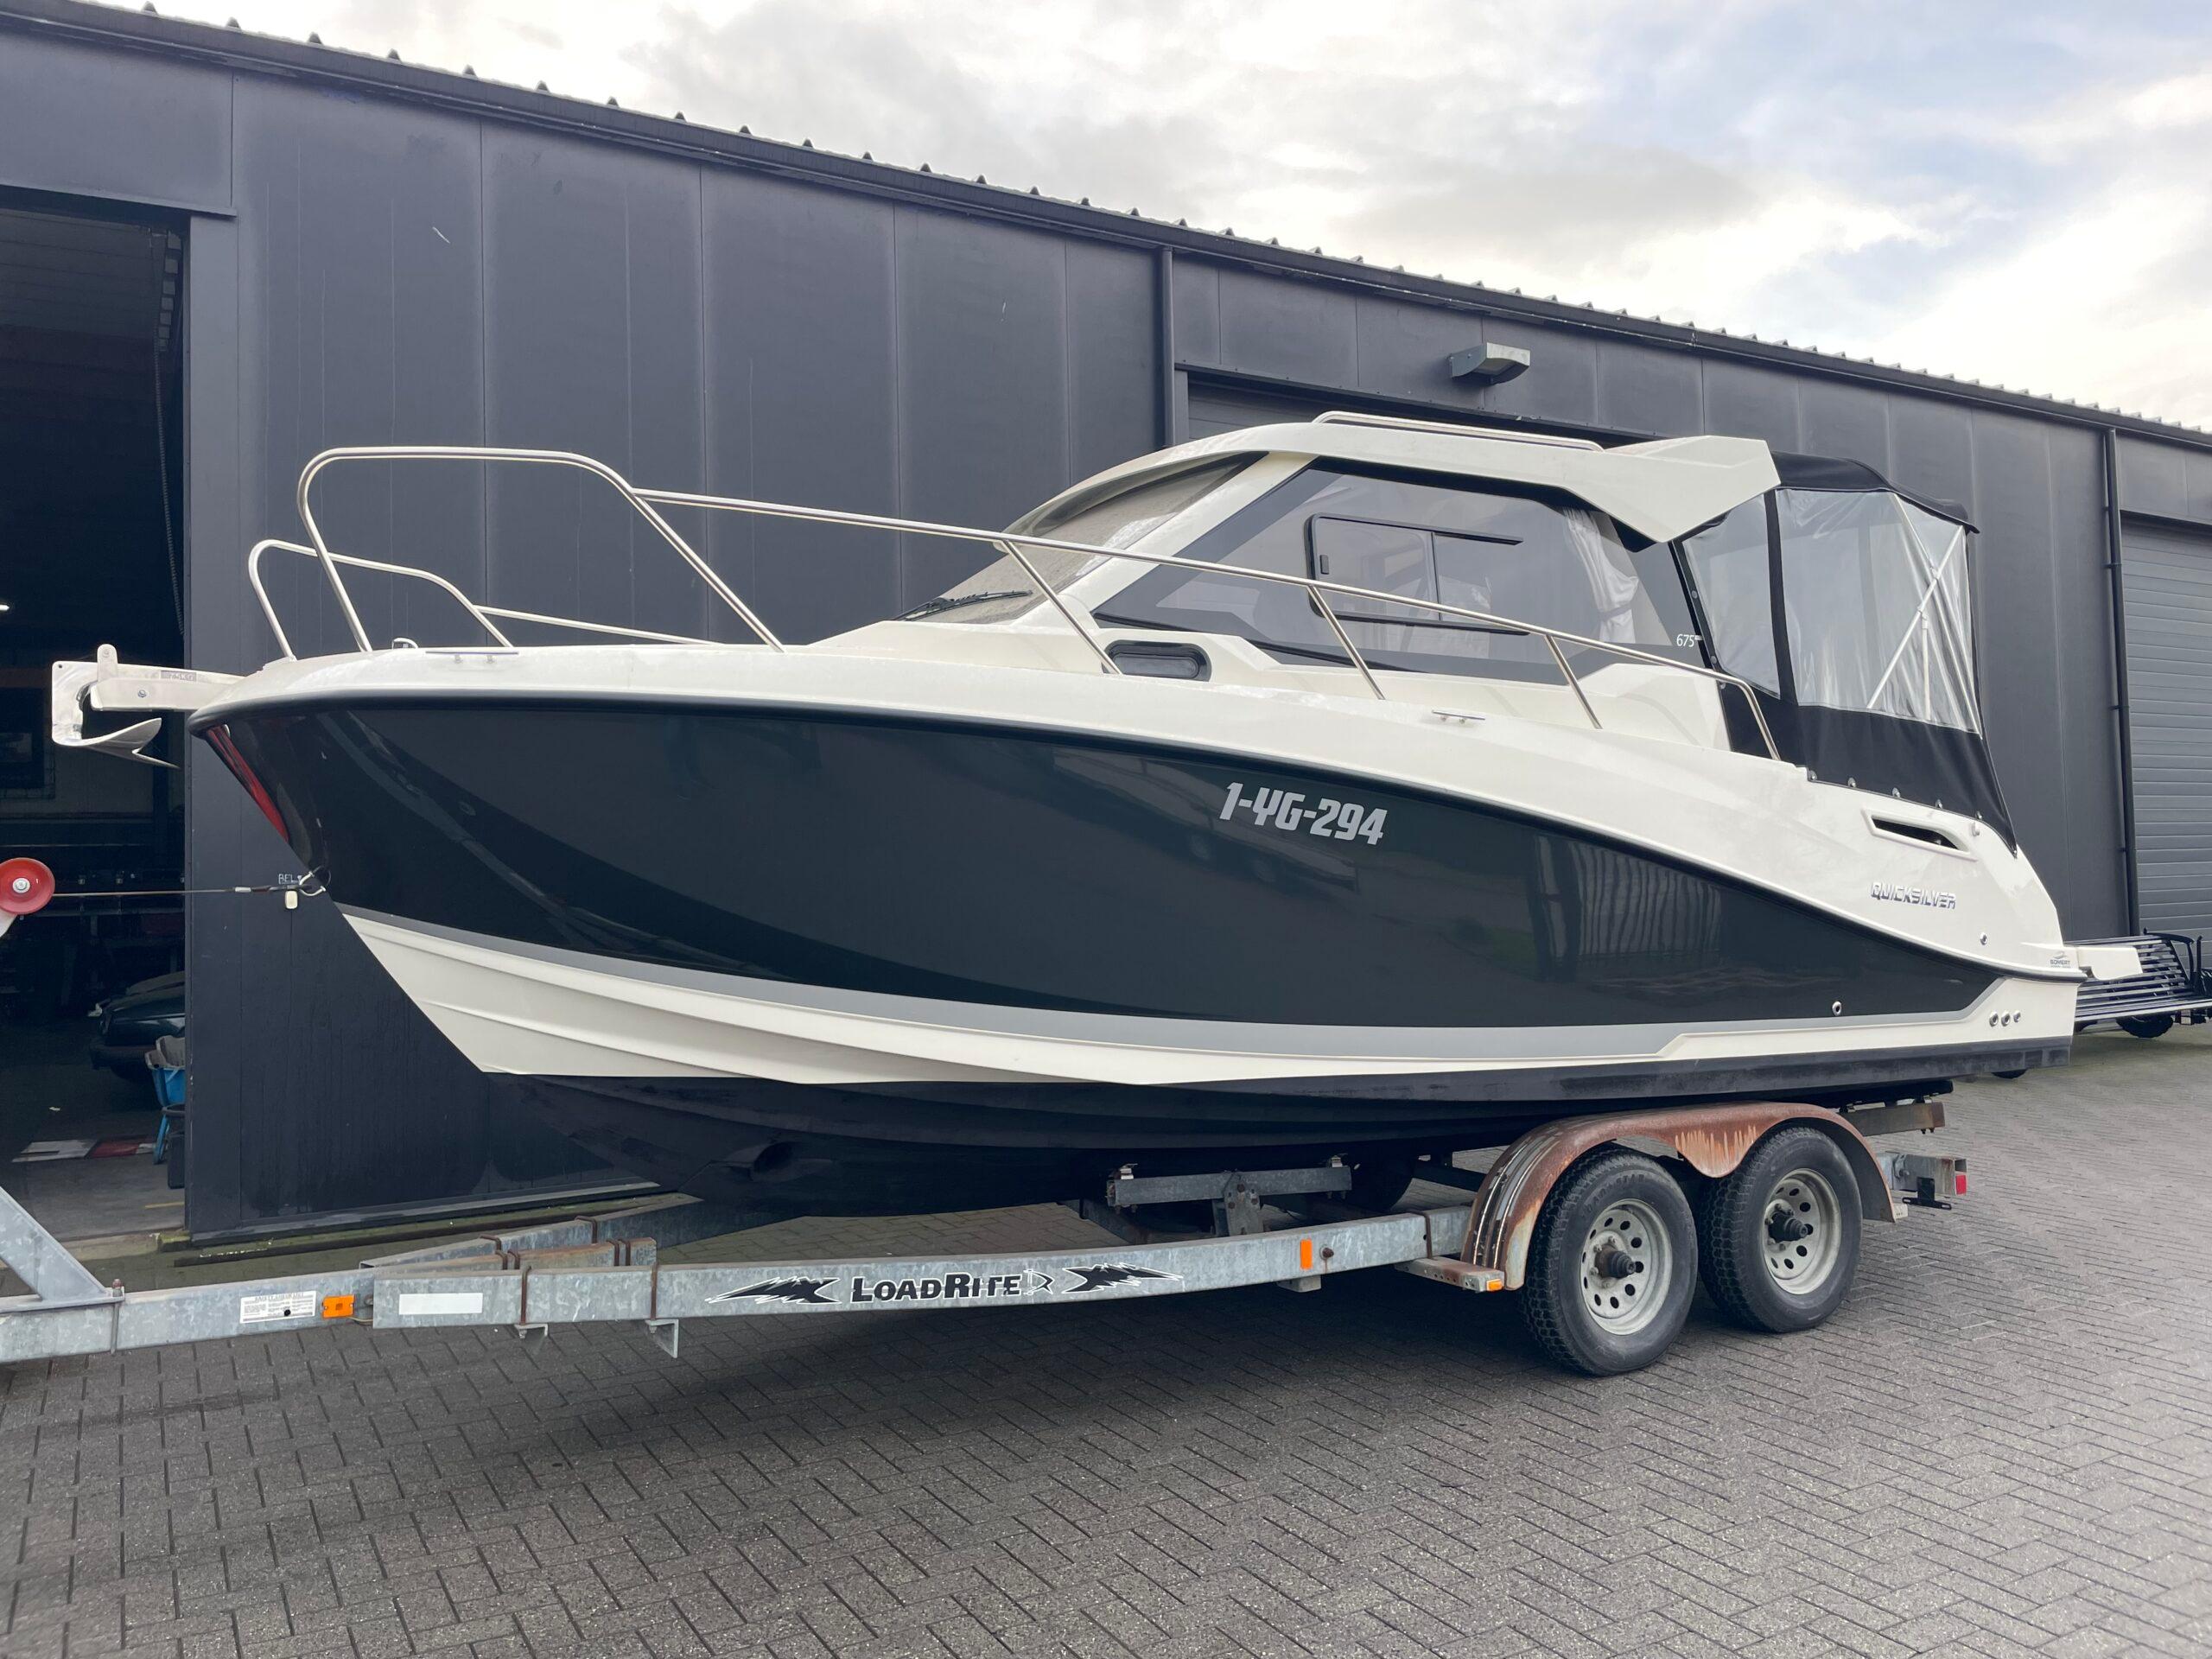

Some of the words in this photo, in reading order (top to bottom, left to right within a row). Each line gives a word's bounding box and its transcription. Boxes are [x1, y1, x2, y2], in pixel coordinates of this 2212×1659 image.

[1676, 633, 1694, 647] 675
[1219, 782, 1388, 845] 1-YG-294
[1871, 881, 1956, 909] QUICKSILVER
